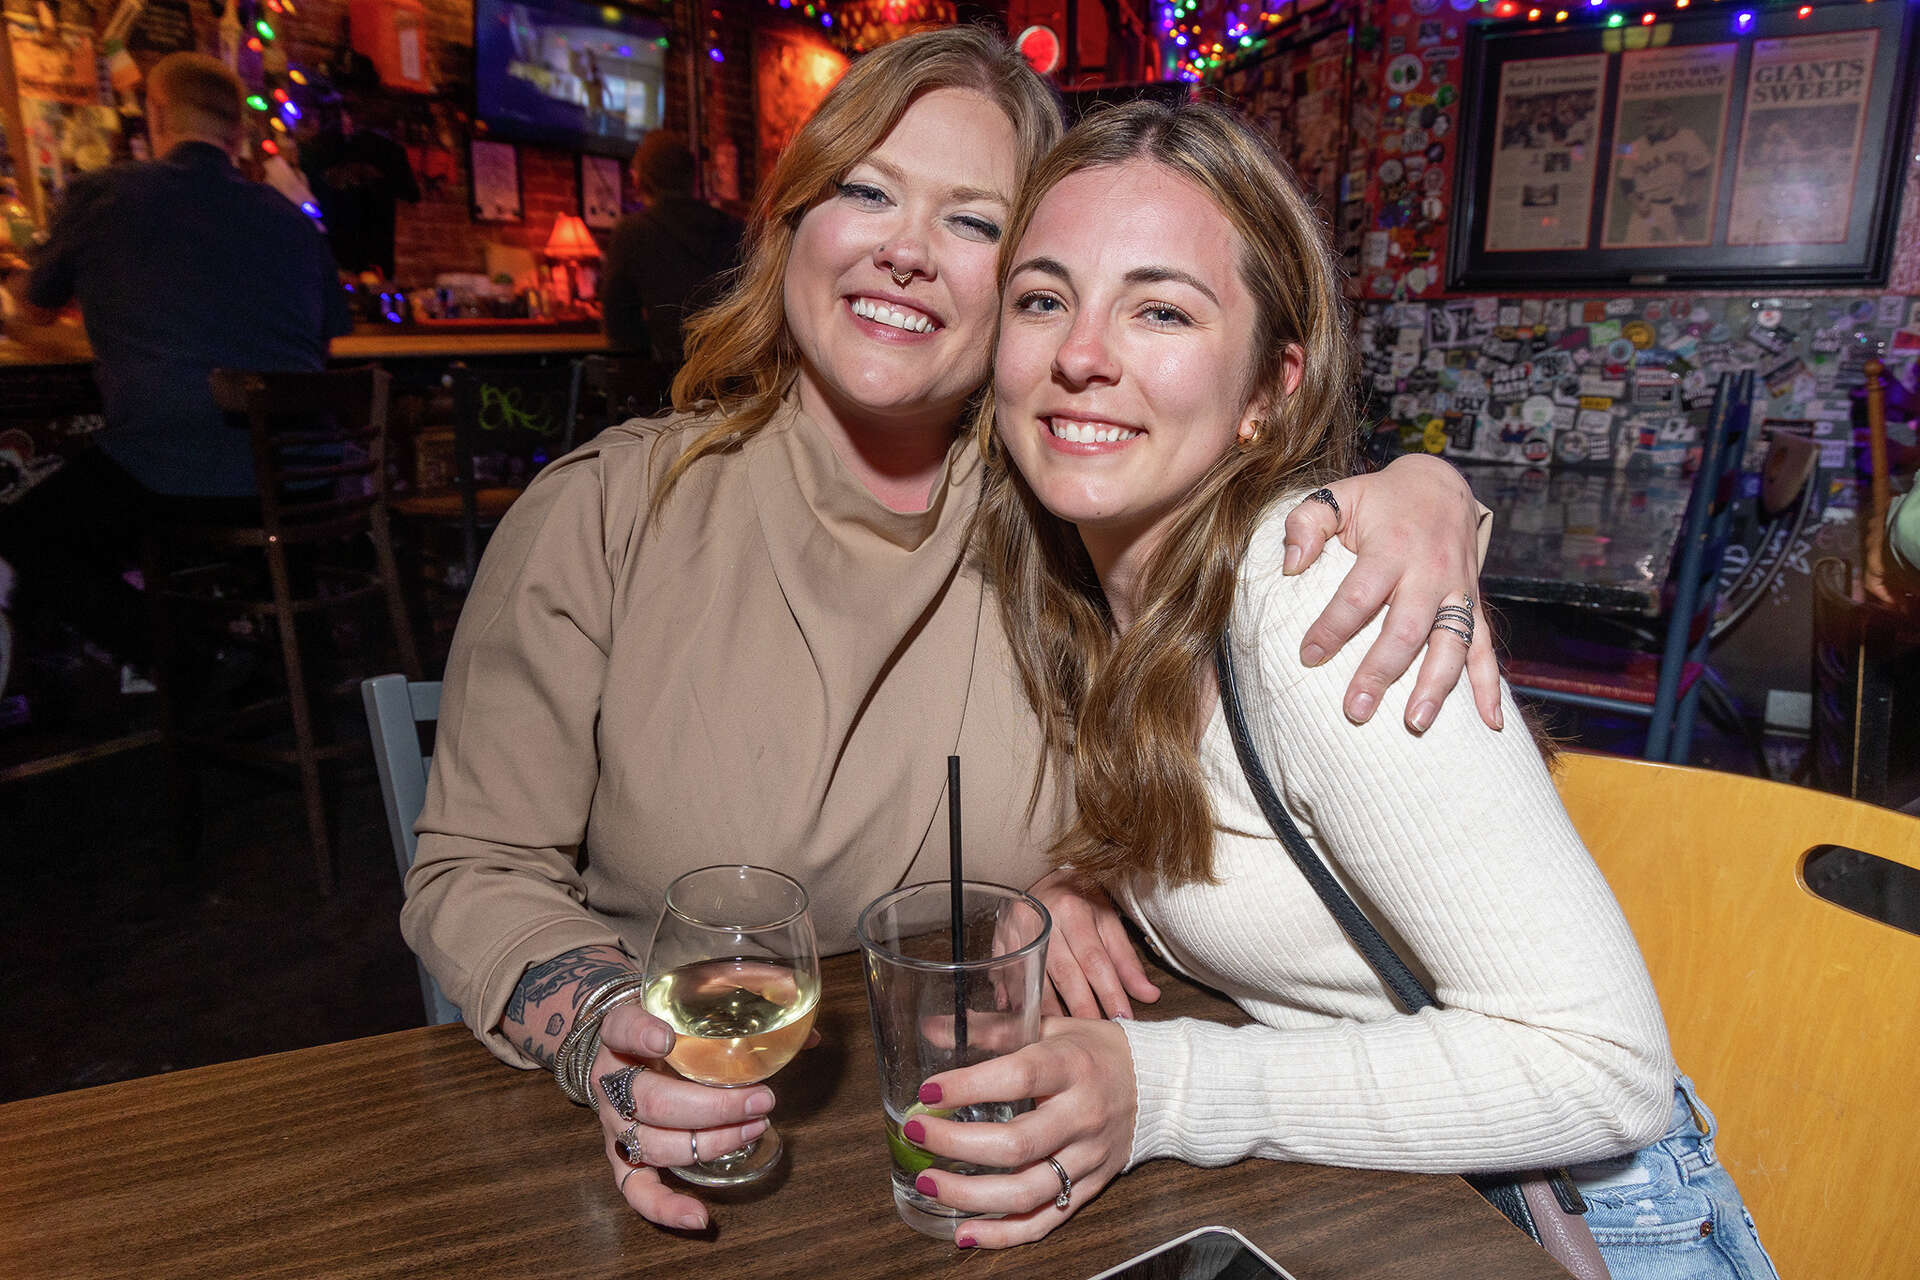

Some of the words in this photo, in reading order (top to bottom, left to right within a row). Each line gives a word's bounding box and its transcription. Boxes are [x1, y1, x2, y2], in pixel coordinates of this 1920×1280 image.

[1630, 67, 1685, 81] GIANTS
[1756, 58, 1864, 85] GIANTS
[1753, 79, 1861, 103] SWEEP!
